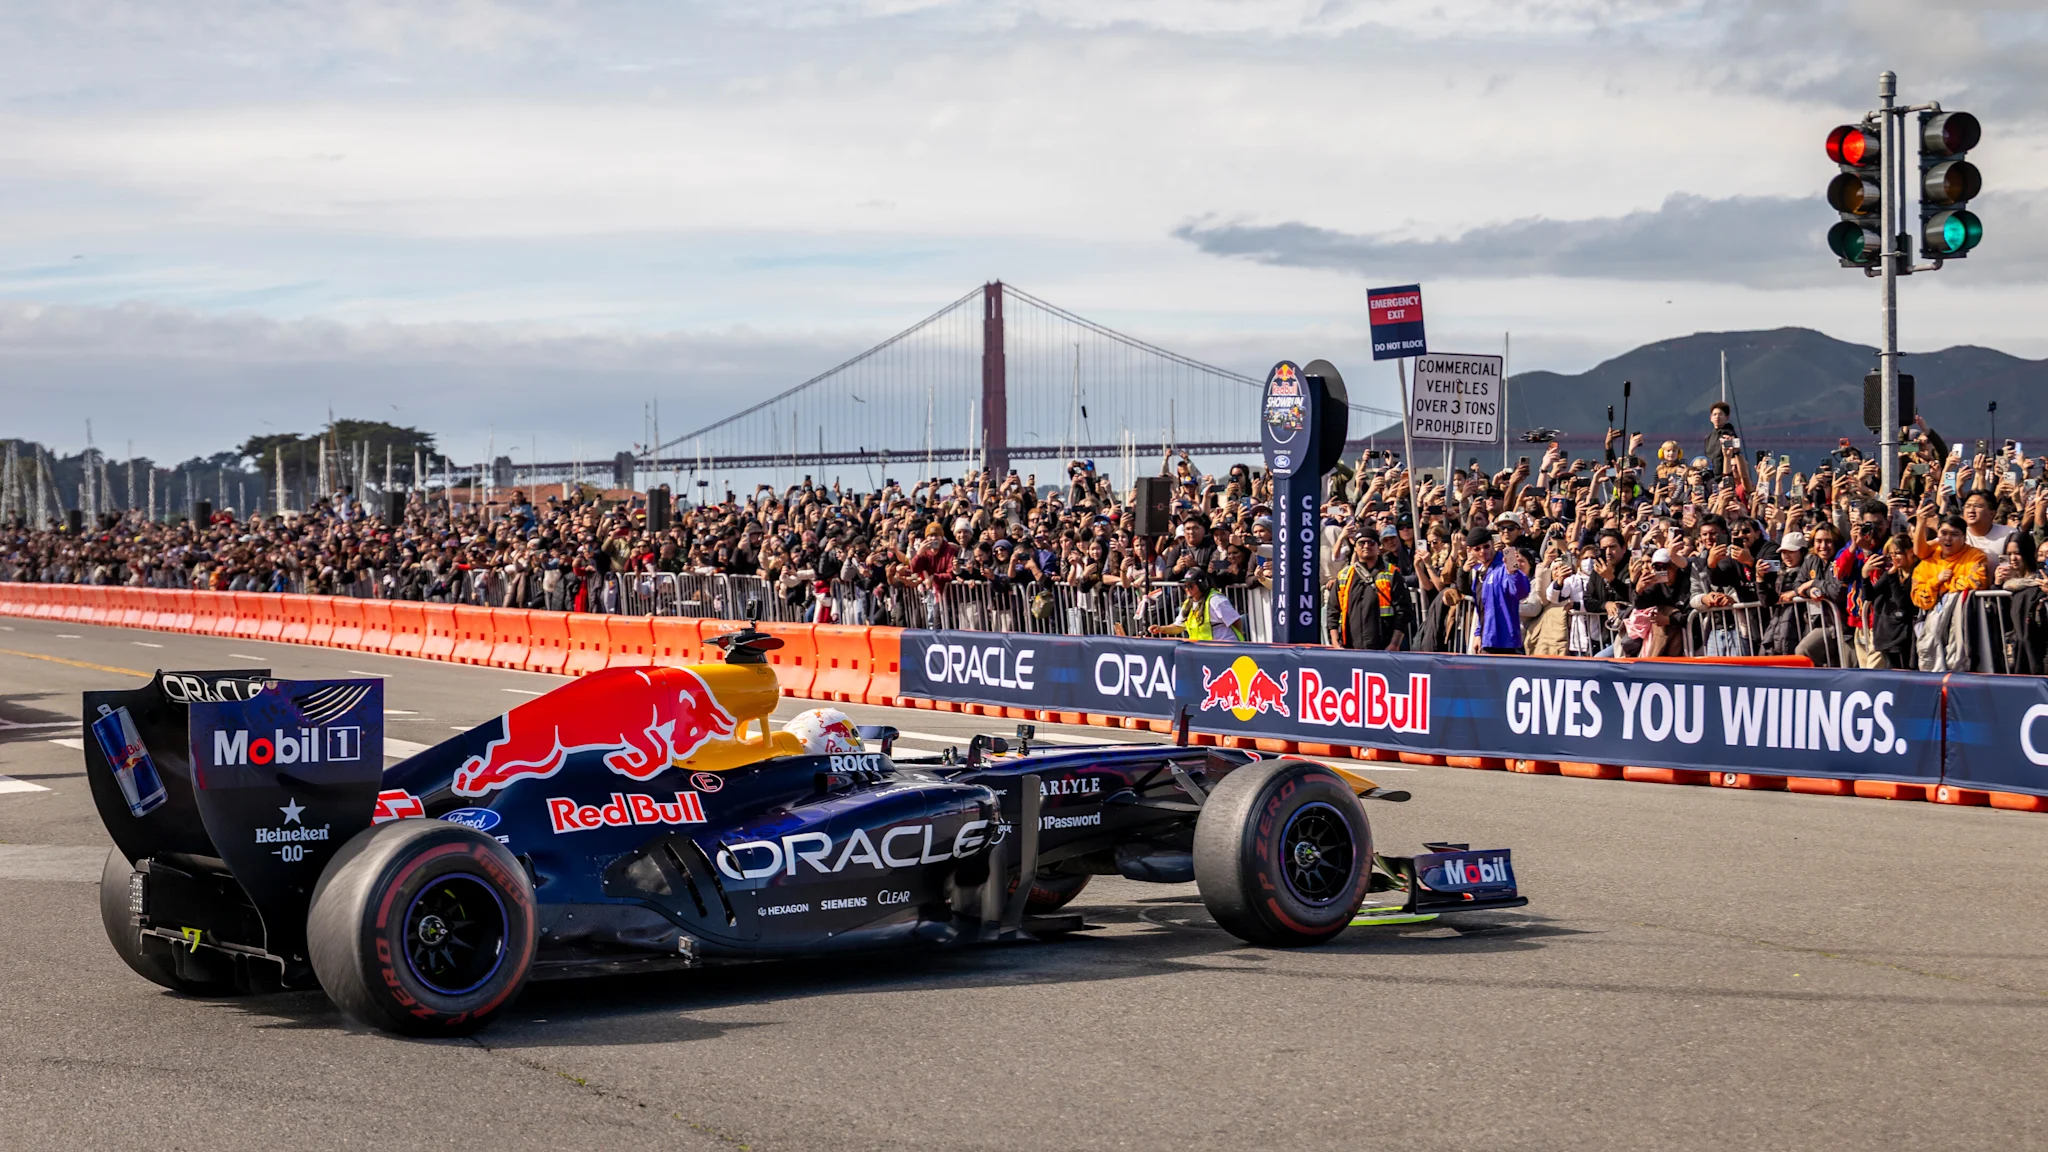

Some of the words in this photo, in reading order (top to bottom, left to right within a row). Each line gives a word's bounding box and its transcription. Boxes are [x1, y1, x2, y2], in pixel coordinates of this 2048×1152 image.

[1370, 296, 1420, 309] EMERGENCY
[1387, 309, 1405, 320] EXIT
[1375, 343, 1385, 351] DO
[1386, 341, 1401, 350] NOT
[1402, 339, 1424, 348] BLOCK
[1418, 359, 1498, 376] COMMERCIAL
[1426, 379, 1489, 395] VEHICLES
[1416, 399, 1447, 413] OVER
[1451, 400, 1461, 414] 3
[1465, 401, 1495, 416] TONS
[1416, 418, 1493, 435] PROHIBITED
[1278, 495, 1287, 625] CROSSING
[1300, 495, 1314, 626] CROSSING
[924, 643, 1035, 690] ORACLE
[1095, 653, 1176, 700] ORA
[1298, 667, 1363, 727] Red
[1364, 672, 1431, 734] Bull
[1506, 676, 1602, 739] GIVES
[1612, 681, 1705, 744] YOU
[1719, 686, 1908, 755] WIIINGS.
[214, 727, 320, 766] Mobil
[829, 755, 881, 772] ROKT
[1039, 777, 1100, 796] ARLYLE
[448, 811, 487, 829] Ford
[546, 793, 632, 834] Red
[626, 790, 708, 825] Bull
[1043, 811, 1101, 830] 1Password
[1256, 779, 1296, 861] ZERO
[255, 826, 329, 843] Heineken
[716, 819, 989, 880] ORACLE
[1444, 856, 1508, 885] Mobil
[768, 903, 809, 916] HEXAGON
[820, 897, 868, 911] SIEMENS
[376, 937, 438, 1020] ZERO
